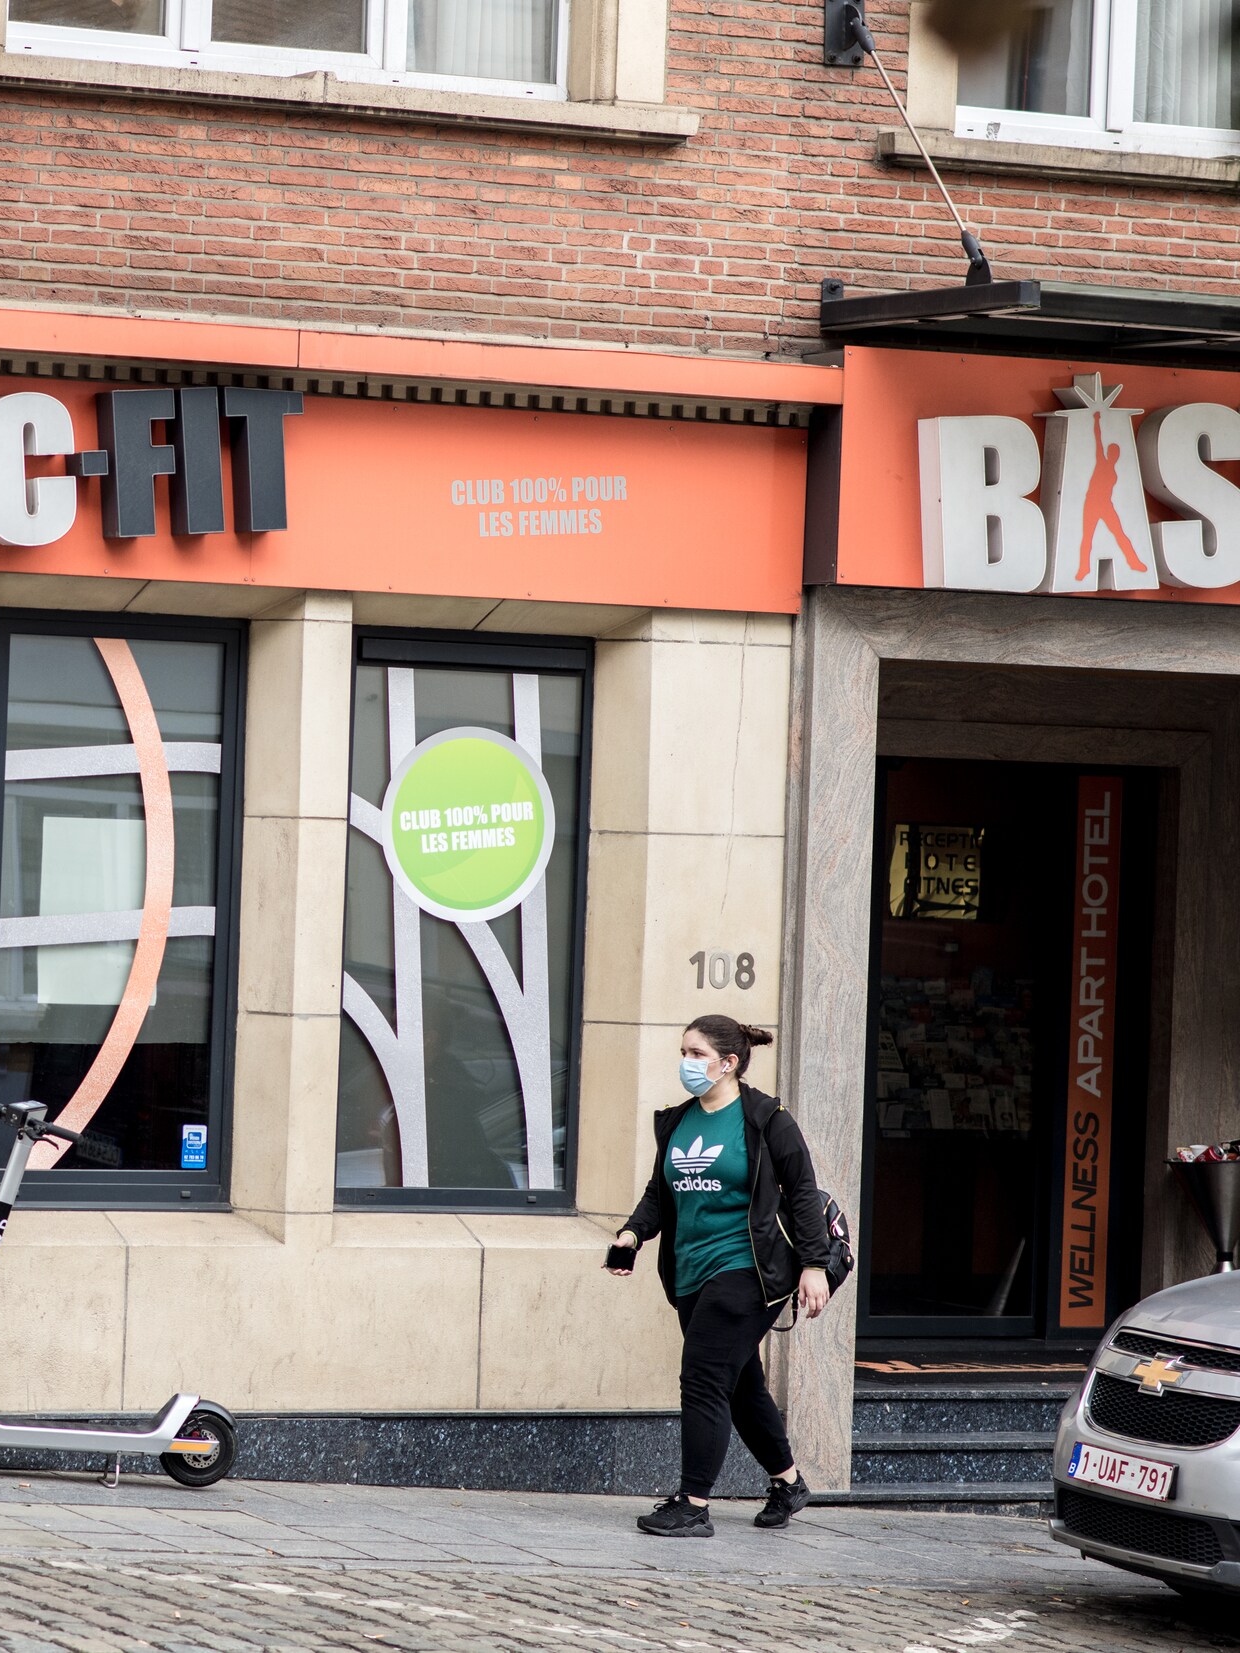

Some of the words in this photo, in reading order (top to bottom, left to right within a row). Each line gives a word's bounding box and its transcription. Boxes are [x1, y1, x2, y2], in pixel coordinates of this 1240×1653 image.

[451, 479, 505, 505] CLUB
[510, 477, 566, 503] 100%
[571, 475, 627, 502] POUR
[479, 511, 513, 537] LES
[518, 508, 602, 536] FEMMES
[400, 809, 441, 831] CLUB
[444, 805, 488, 828] 100%
[491, 801, 533, 823] POUR
[421, 832, 448, 854] LES
[452, 827, 515, 851] FEMMES
[1081, 791, 1111, 938] HOTEL
[689, 951, 755, 990] 108
[1076, 947, 1107, 1098] APART
[672, 1176, 722, 1191] adidas
[1068, 1110, 1100, 1308] WELLNESS
